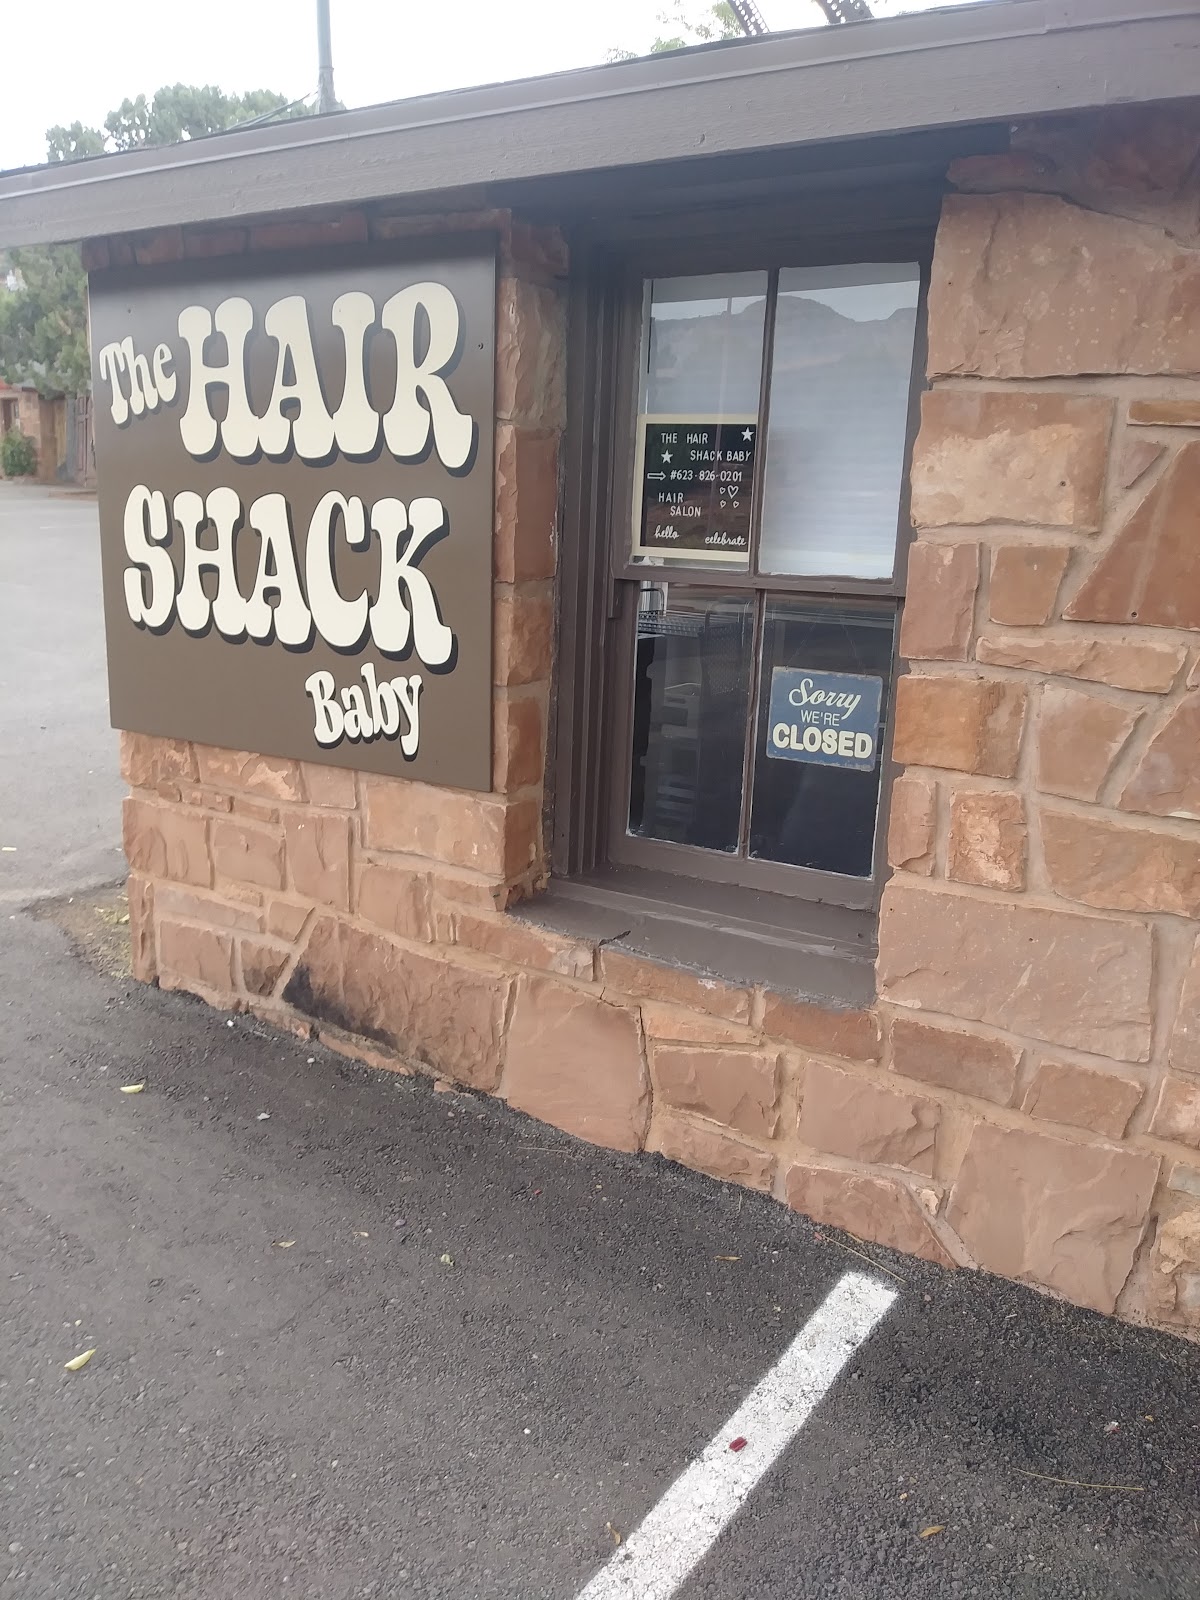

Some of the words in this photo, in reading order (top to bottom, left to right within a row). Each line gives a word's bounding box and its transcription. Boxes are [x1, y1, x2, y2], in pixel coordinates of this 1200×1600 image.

[100, 336, 176, 425] The
[178, 281, 473, 469] HAIR
[660, 432, 678, 444] THE
[686, 432, 709, 444] HAIR
[690, 450, 723, 462] SHACK
[726, 451, 751, 462] BABY
[658, 492, 684, 503] HAIR
[670, 506, 702, 518] SALON
[654, 524, 679, 539] hello
[705, 531, 746, 546] celebrate
[123, 484, 452, 666] SHACK
[788, 678, 861, 720] Sorry
[305, 662, 422, 756] Baby
[801, 709, 840, 726] WE'RE
[772, 722, 872, 759] CLOSED
